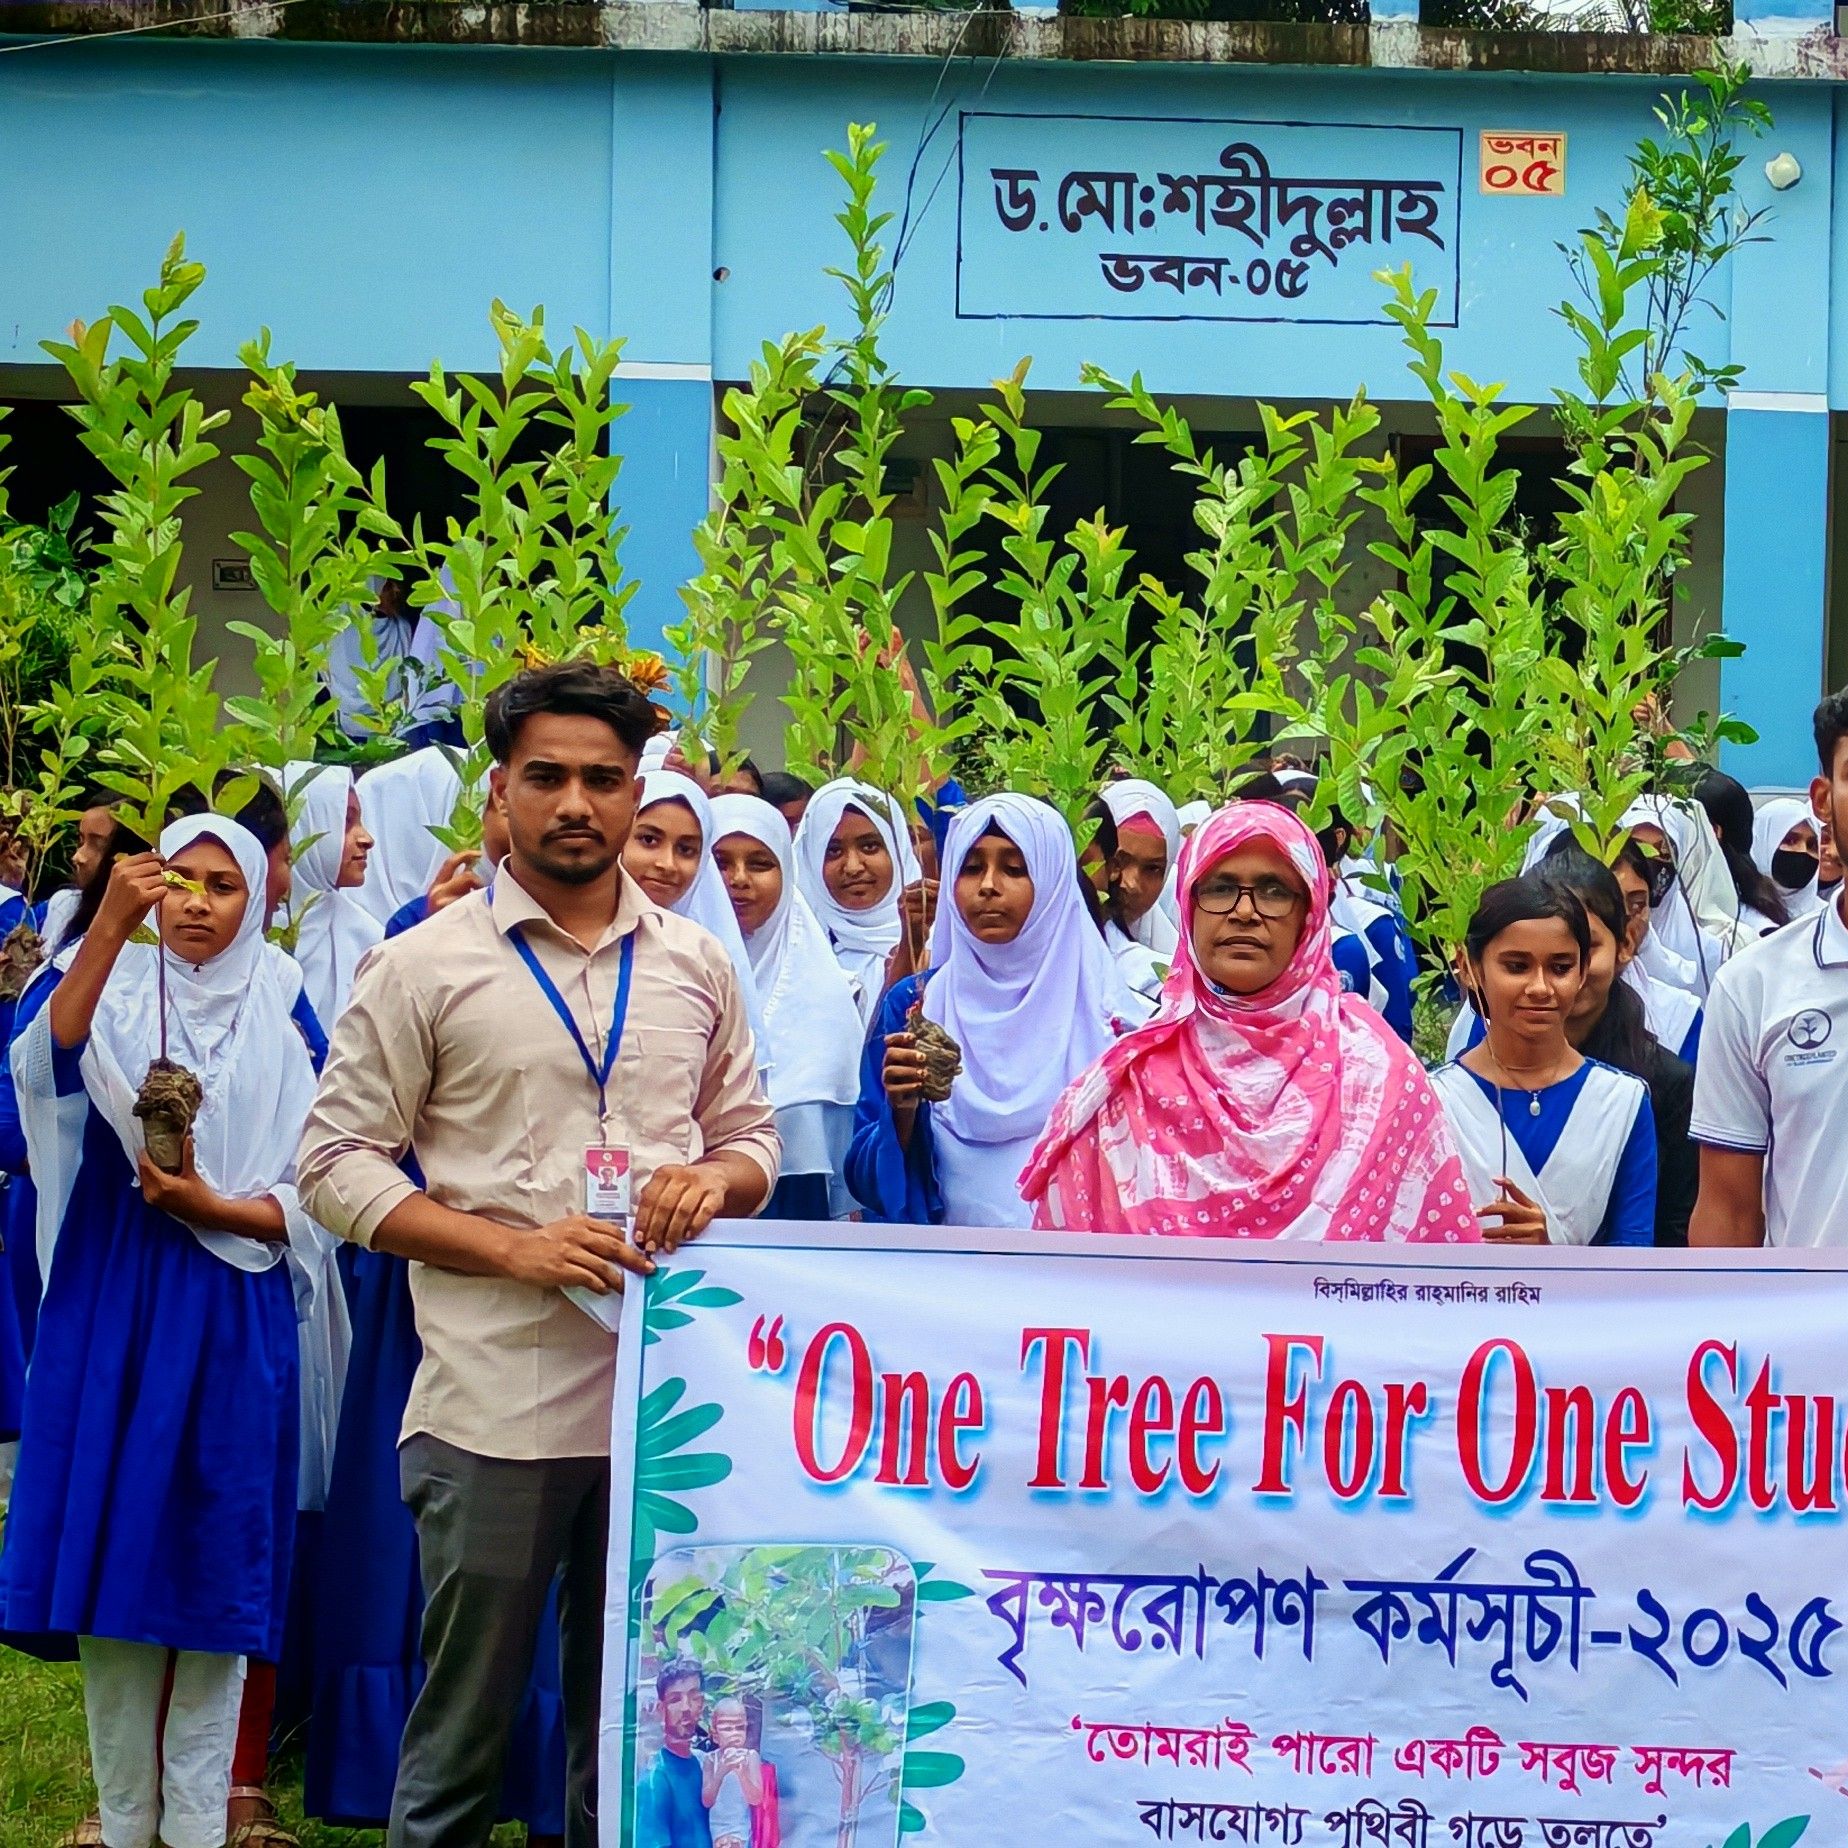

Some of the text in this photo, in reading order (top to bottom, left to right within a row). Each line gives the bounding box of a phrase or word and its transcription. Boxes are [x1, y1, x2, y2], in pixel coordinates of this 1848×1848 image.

[1485, 137, 1561, 160] ভবন
[1484, 160, 1559, 192] ০৫
[1100, 252, 1310, 299] ভবন-০৫
[1495, 1281, 1542, 1304] রাহিম
[748, 1313, 985, 1490] “One
[1020, 1327, 1224, 1494] Tree
[1252, 1332, 1426, 1499] For
[1456, 1338, 1650, 1508] One
[980, 1547, 1843, 1702] বৃক্ষরোপণ কর্মসূচী-২০২৫
[1271, 1731, 1380, 1779] পারো
[1395, 1726, 1506, 1781] একটি
[1518, 1742, 1621, 1797] সবুজ
[1630, 1746, 1737, 1799] সুন্দর
[1136, 1796, 1312, 1846] বাসযোগ্য
